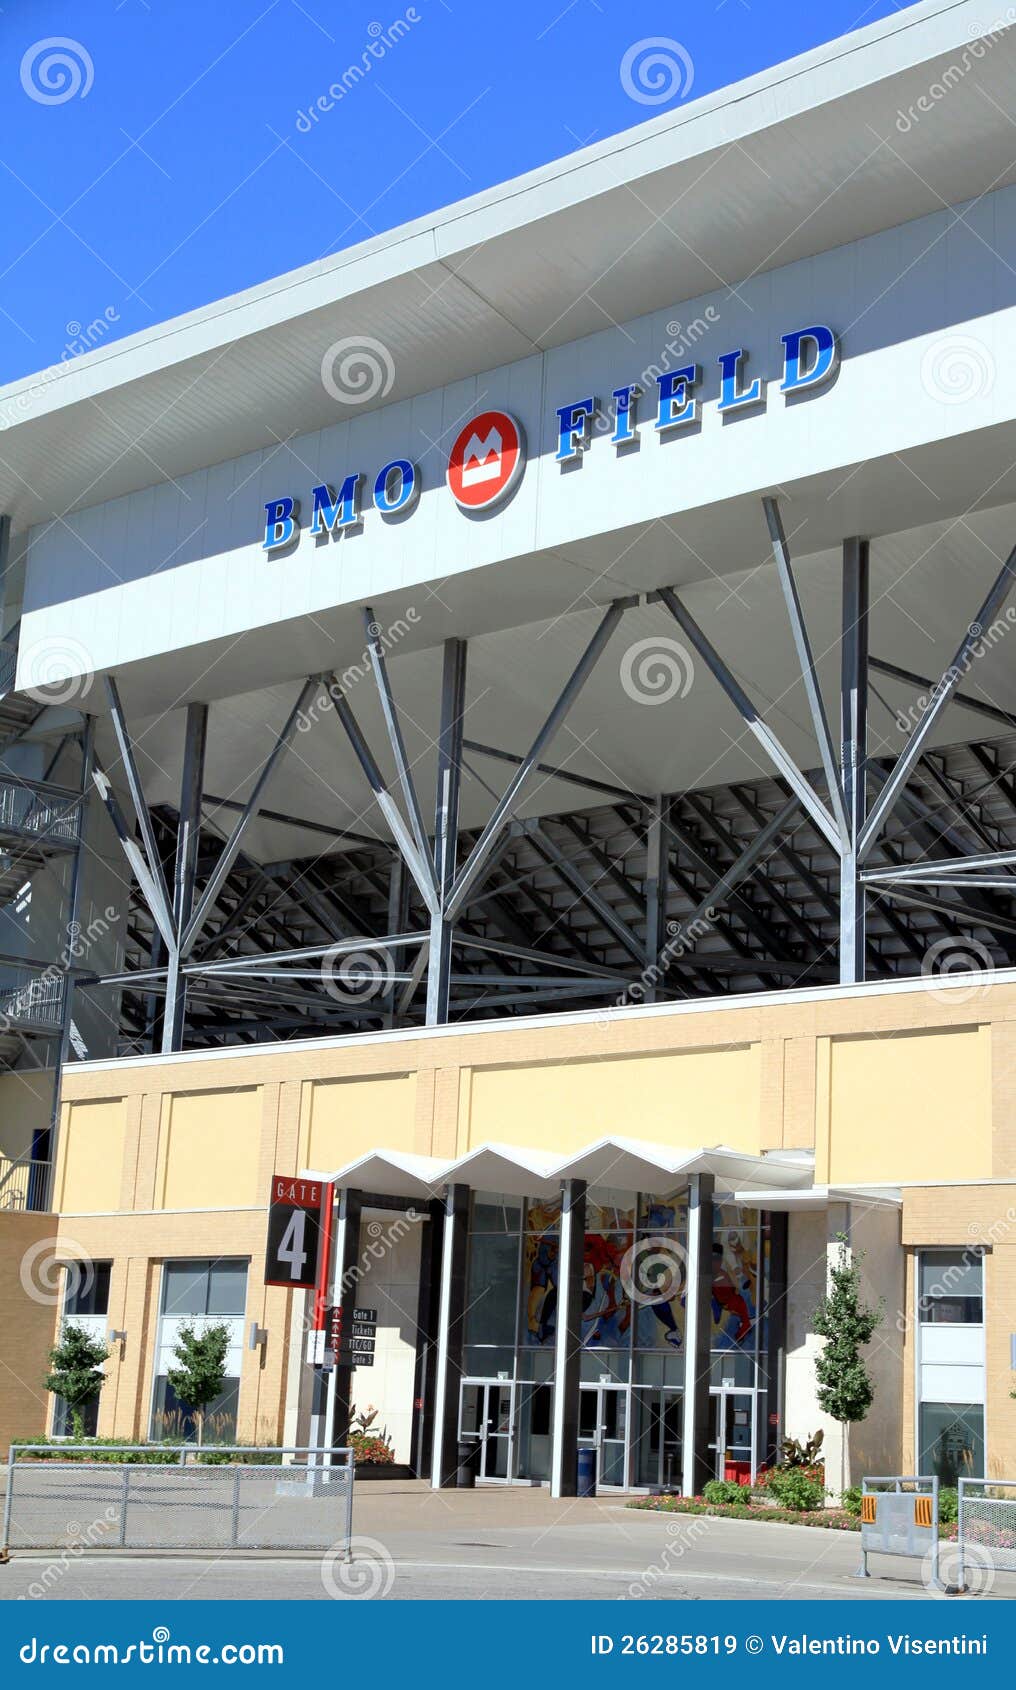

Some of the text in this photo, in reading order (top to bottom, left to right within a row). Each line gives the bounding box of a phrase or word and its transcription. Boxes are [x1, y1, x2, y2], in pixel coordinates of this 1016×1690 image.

[261, 325, 842, 552] BMO FIELD
[277, 1182, 317, 1202] GATE
[277, 1209, 307, 1280] 4
[353, 1309, 368, 1319] Gate
[351, 1324, 374, 1336] Tickets
